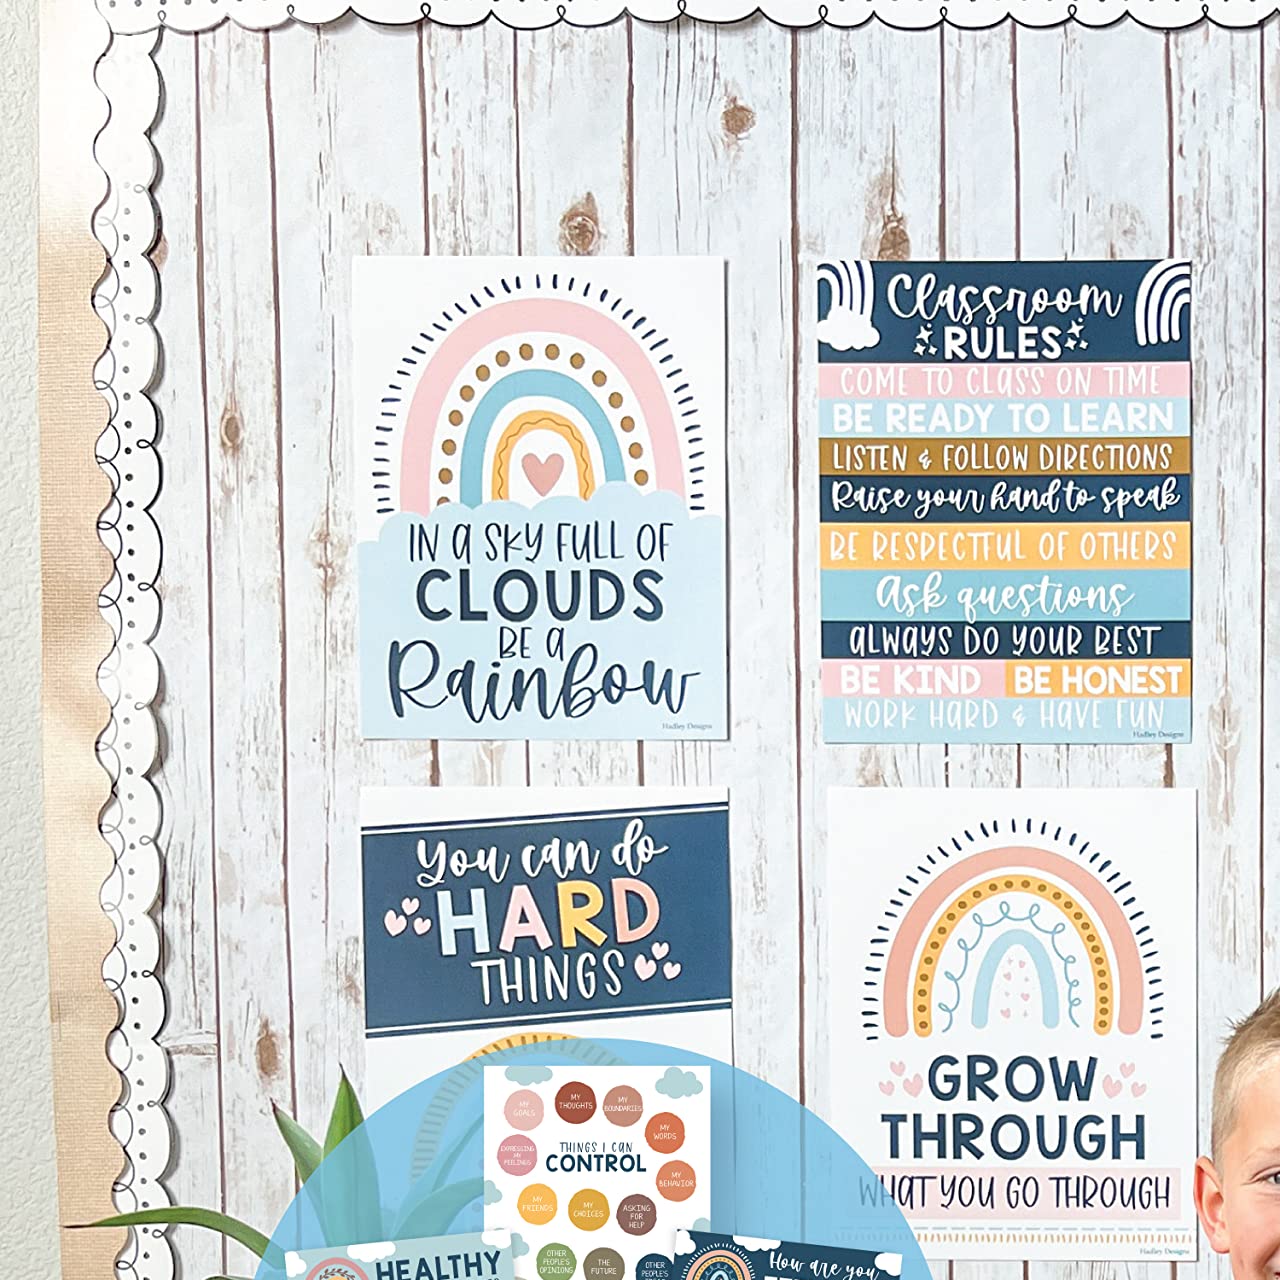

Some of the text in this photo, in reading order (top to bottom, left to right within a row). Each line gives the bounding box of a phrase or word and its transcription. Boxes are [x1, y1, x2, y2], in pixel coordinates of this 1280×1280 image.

[887, 273, 1123, 325] Classroom
[944, 326, 1062, 360] RULES
[834, 402, 1173, 433] BE READY TO LEARN
[834, 443, 907, 471] LISTEN
[944, 445, 1028, 470] FOLLOW
[1041, 443, 1172, 470] DIRECTIONS
[832, 479, 1181, 519] Raise your hand to speak
[410, 523, 673, 562] IN SKY FULL OF
[416, 569, 664, 622] CLOUDS
[958, 575, 1135, 623] questions
[499, 627, 532, 659] BE
[388, 639, 700, 723] Rainbow
[841, 666, 1183, 693] BE KIND BE HONEST
[416, 818, 669, 888] You can do
[436, 877, 660, 956] HARD
[471, 949, 625, 1005] THINGS
[928, 1054, 1098, 1102] GROW
[881, 1113, 1145, 1160] THROUGH
[941, 1175, 1170, 1209] YOU GO THROUGH
